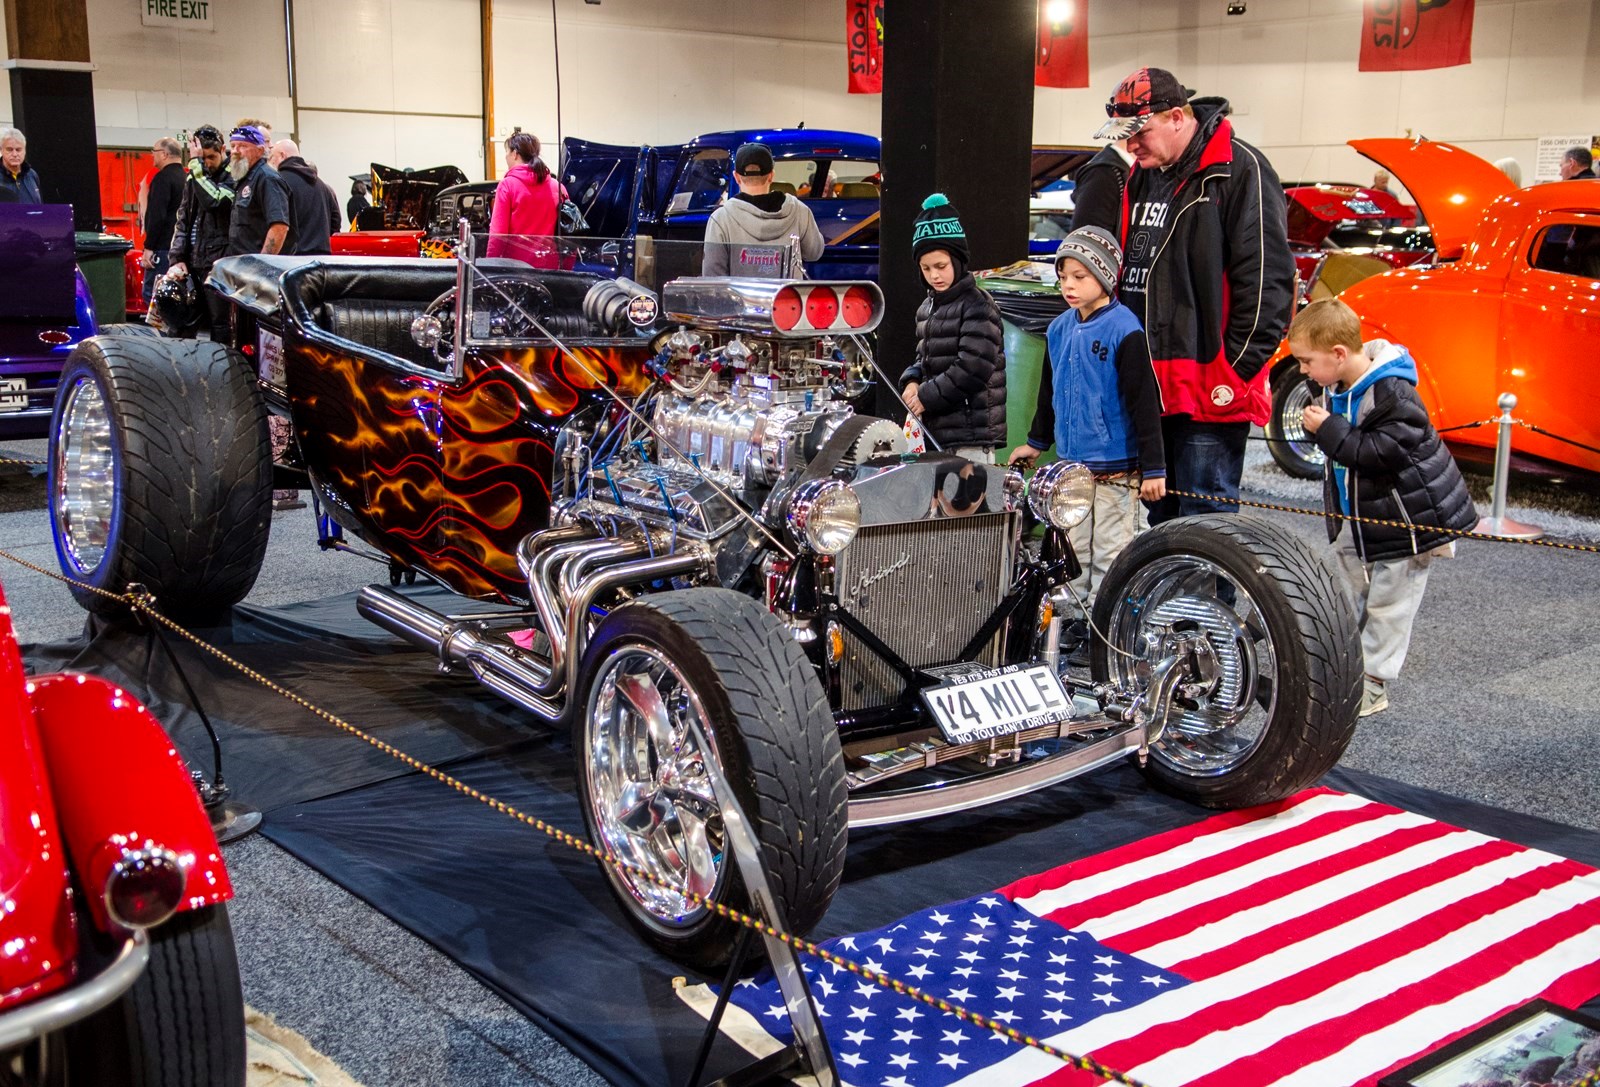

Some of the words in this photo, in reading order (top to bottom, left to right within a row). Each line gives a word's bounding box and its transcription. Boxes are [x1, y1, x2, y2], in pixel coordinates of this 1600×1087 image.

[147, 0, 178, 18] FIRE
[181, 0, 208, 20] EXIT
[1091, 253, 1117, 285] RUSTY
[952, 676, 968, 686] YES
[967, 672, 983, 682] IT'S
[983, 668, 1002, 679] FAST
[1002, 664, 1019, 675] AND
[979, 671, 1062, 721] MILE
[955, 732, 973, 744] NO
[973, 727, 995, 741] YOU
[996, 721, 1024, 736] CAN'T
[1027, 712, 1056, 730] DRIVE
